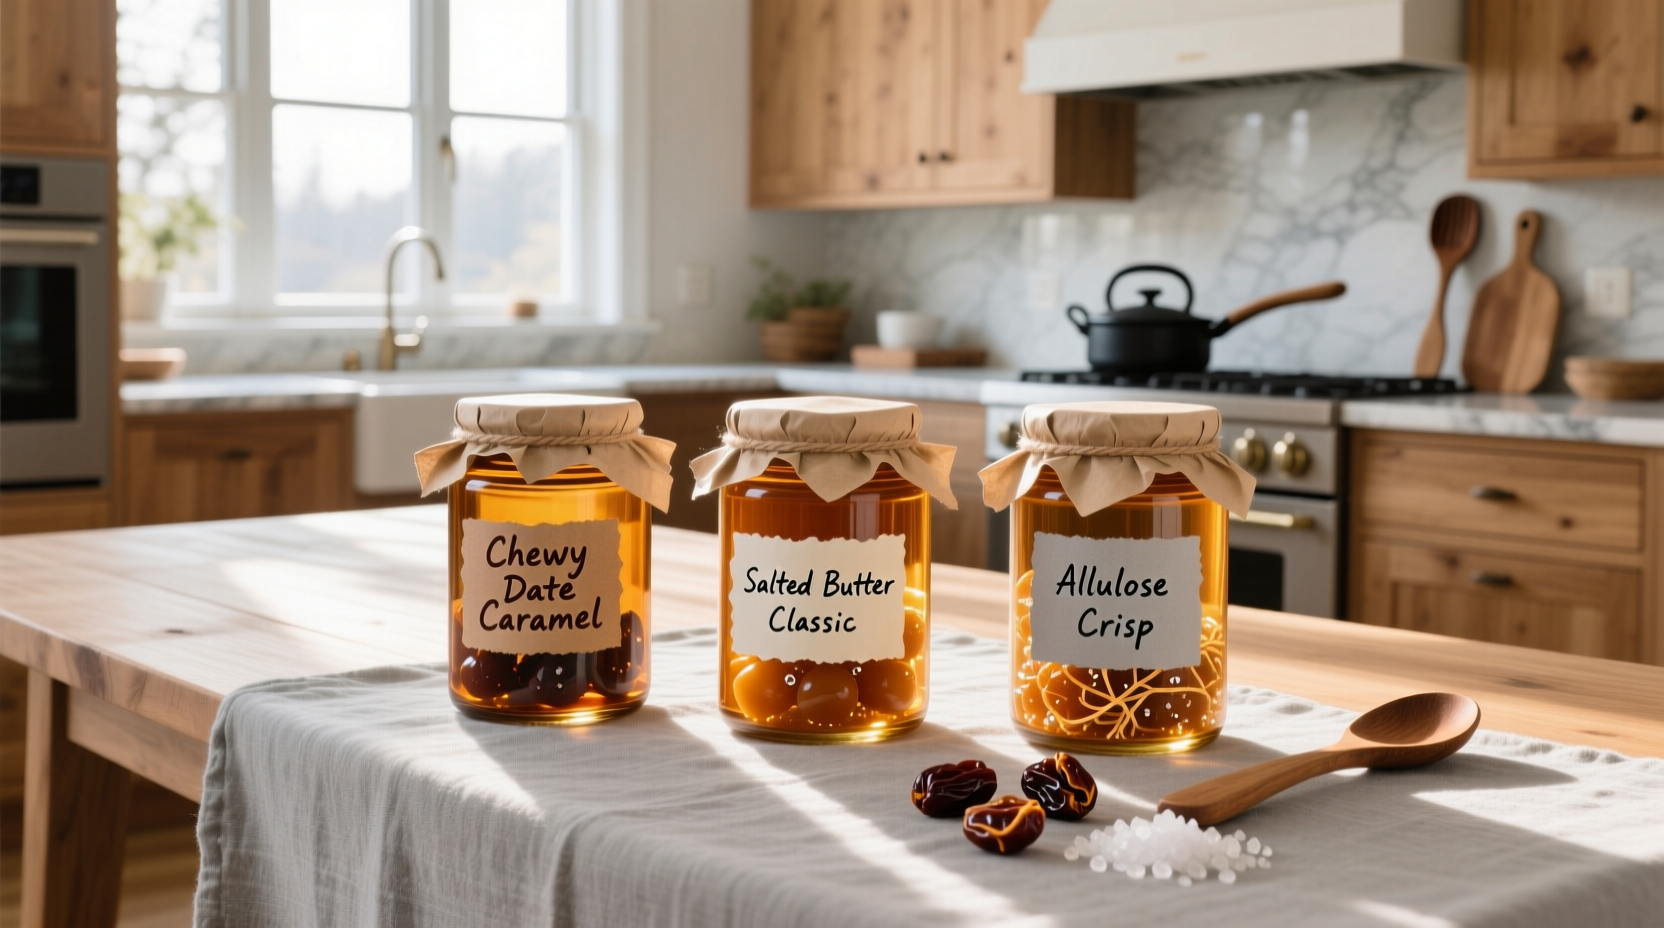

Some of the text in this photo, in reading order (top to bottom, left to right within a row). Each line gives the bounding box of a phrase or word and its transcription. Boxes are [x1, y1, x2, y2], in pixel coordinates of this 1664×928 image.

[486, 534, 587, 579] Chewy
[503, 574, 576, 604] Date
[743, 566, 895, 598] Salted Butter
[1056, 563, 1168, 598] Allulose
[479, 596, 603, 632] Caramel
[769, 605, 857, 633] Classic
[1077, 607, 1154, 650] Crisp
